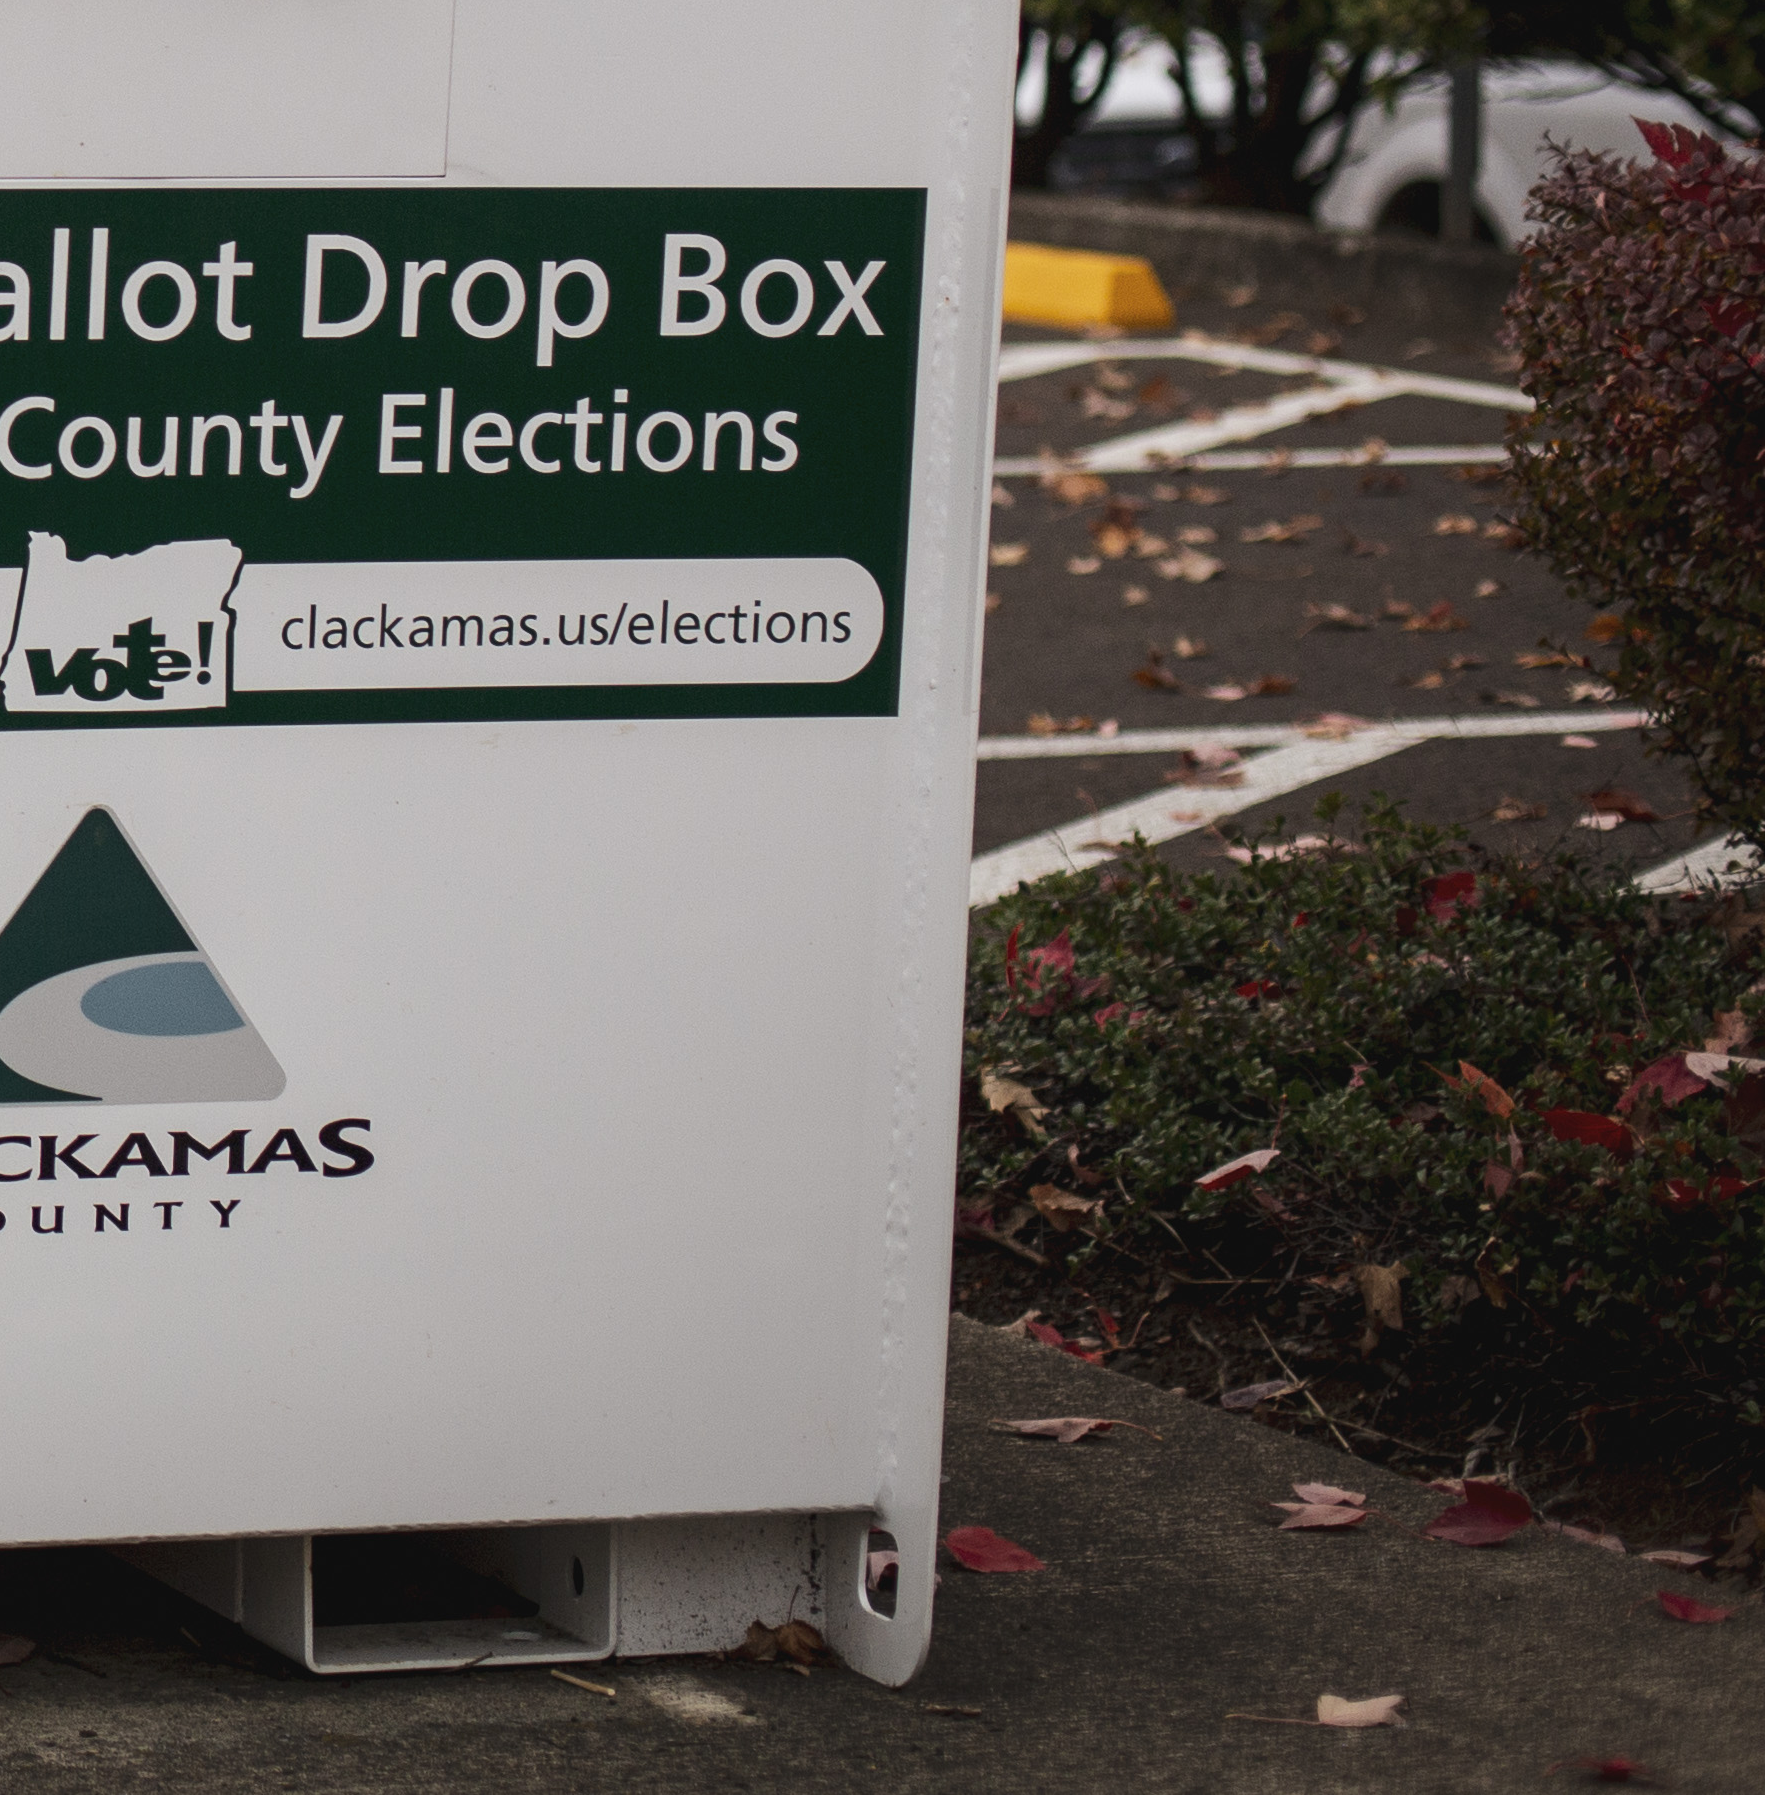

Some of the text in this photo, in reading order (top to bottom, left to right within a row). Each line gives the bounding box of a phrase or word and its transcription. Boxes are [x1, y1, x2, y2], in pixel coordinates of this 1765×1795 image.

[302, 233, 610, 367] Drop
[659, 233, 887, 339] Box
[378, 387, 799, 474] Elections
[24, 616, 214, 702] vote!
[281, 599, 851, 650] clackamas.us/elections
